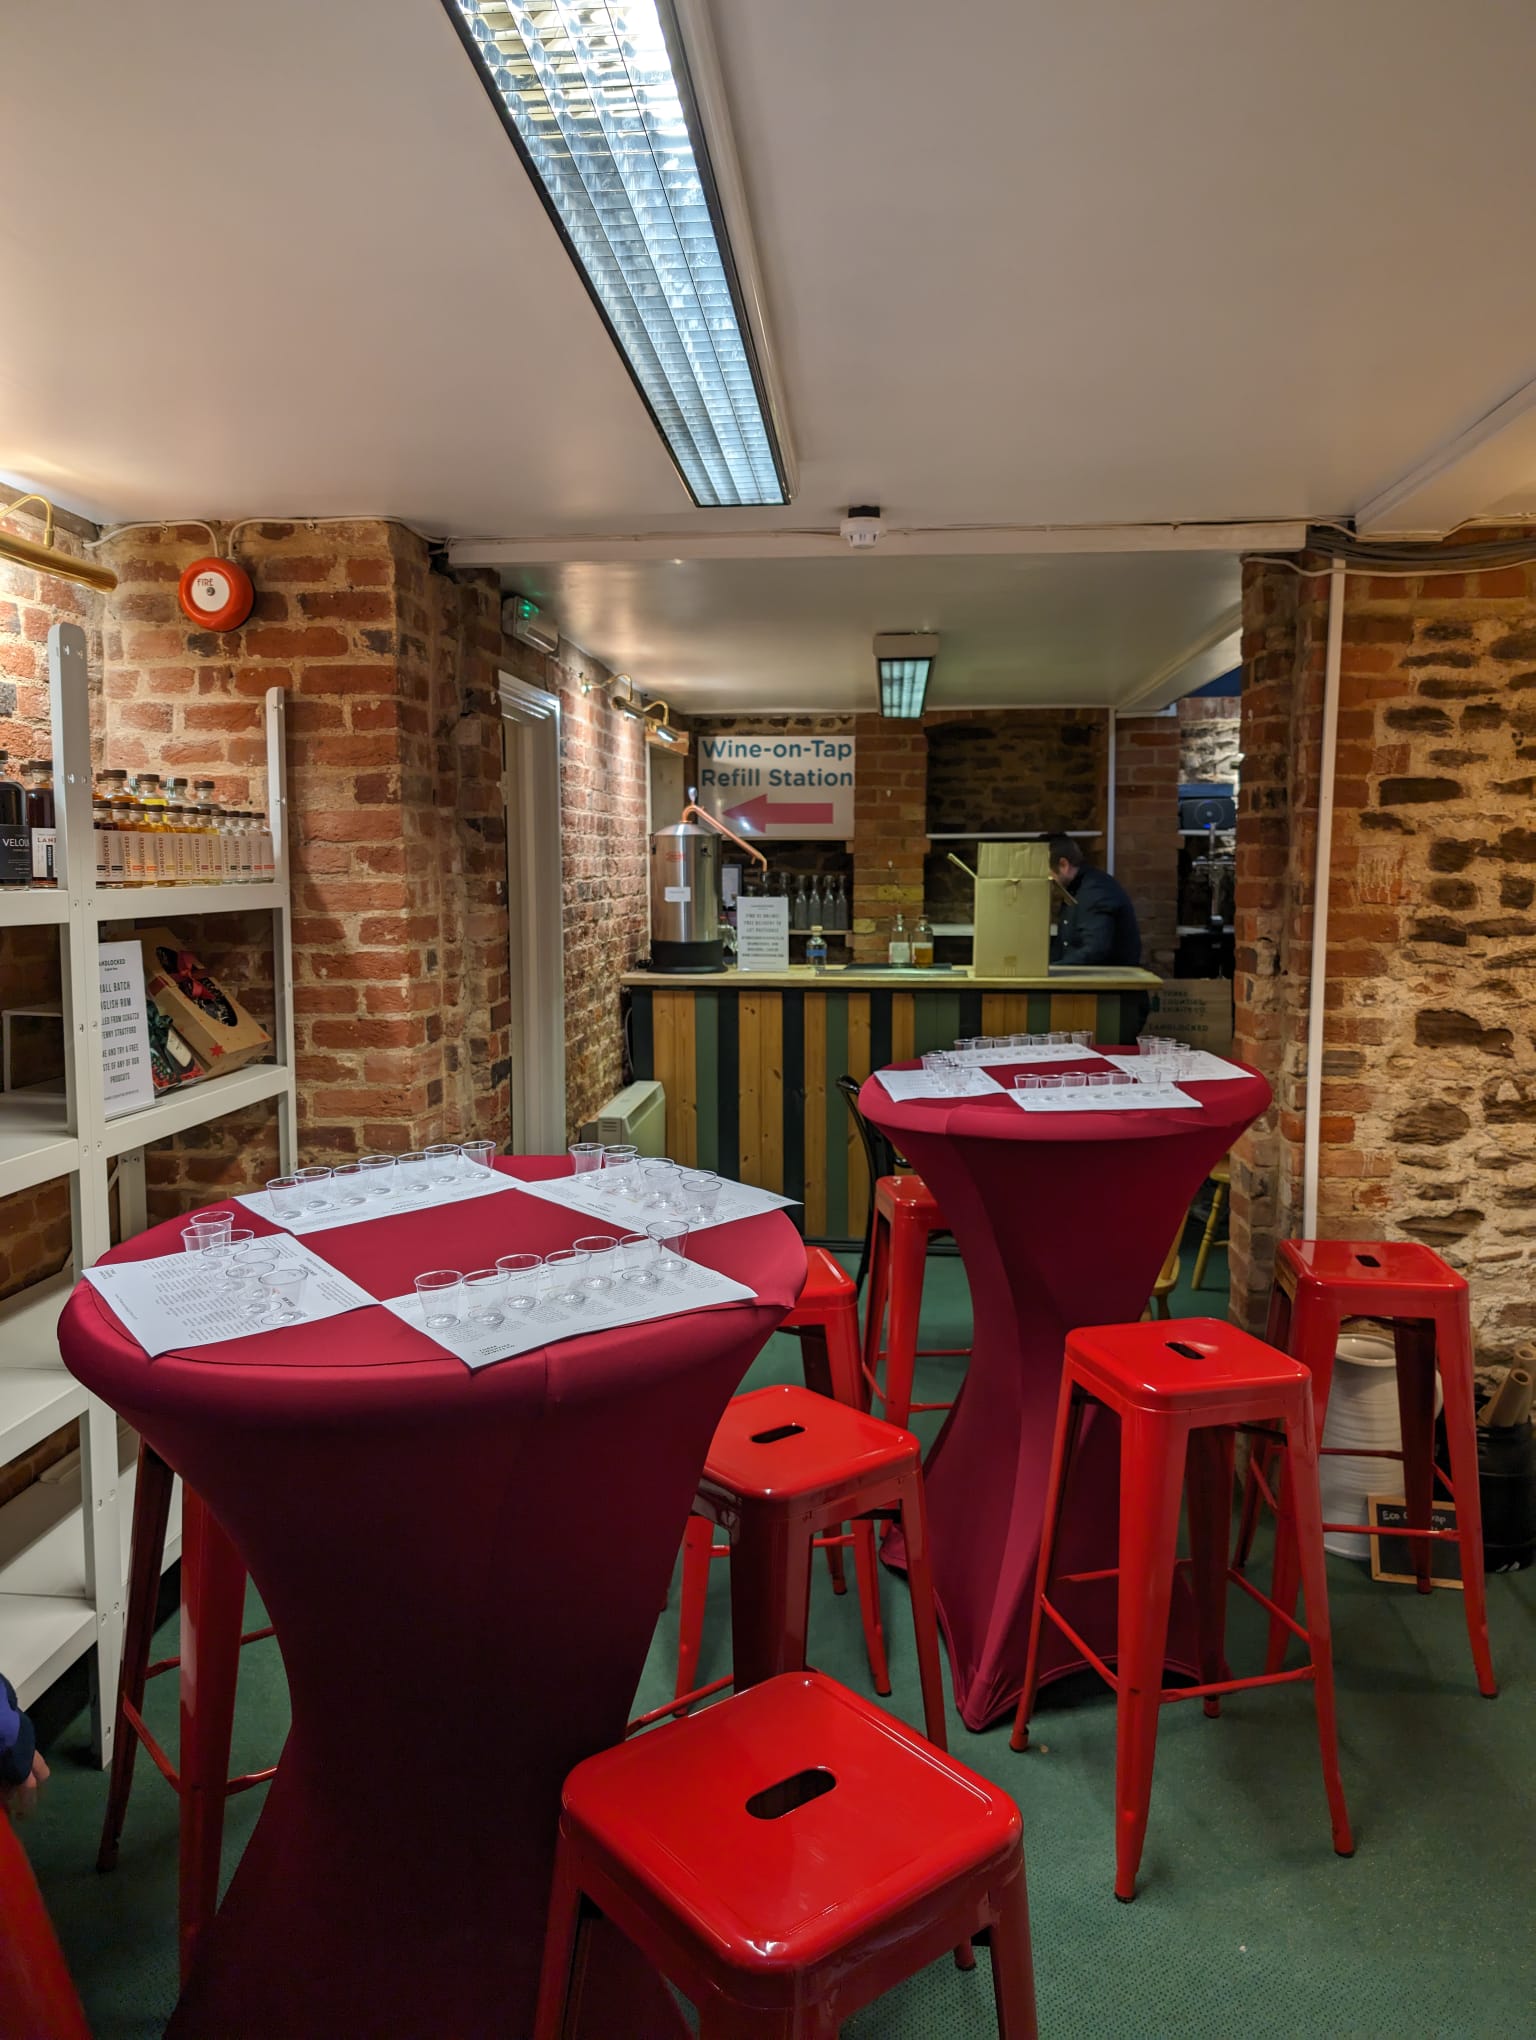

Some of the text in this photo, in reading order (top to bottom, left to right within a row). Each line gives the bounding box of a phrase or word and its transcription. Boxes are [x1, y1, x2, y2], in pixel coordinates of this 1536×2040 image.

[197, 578, 214, 587] FIRE
[702, 740, 853, 761] Wine-on-Tap
[701, 768, 853, 787] Refill Station
[113, 982, 130, 992] BATCH
[120, 998, 131, 1007] RUM
[110, 1014, 121, 1024] FROM
[108, 1047, 116, 1057] AND
